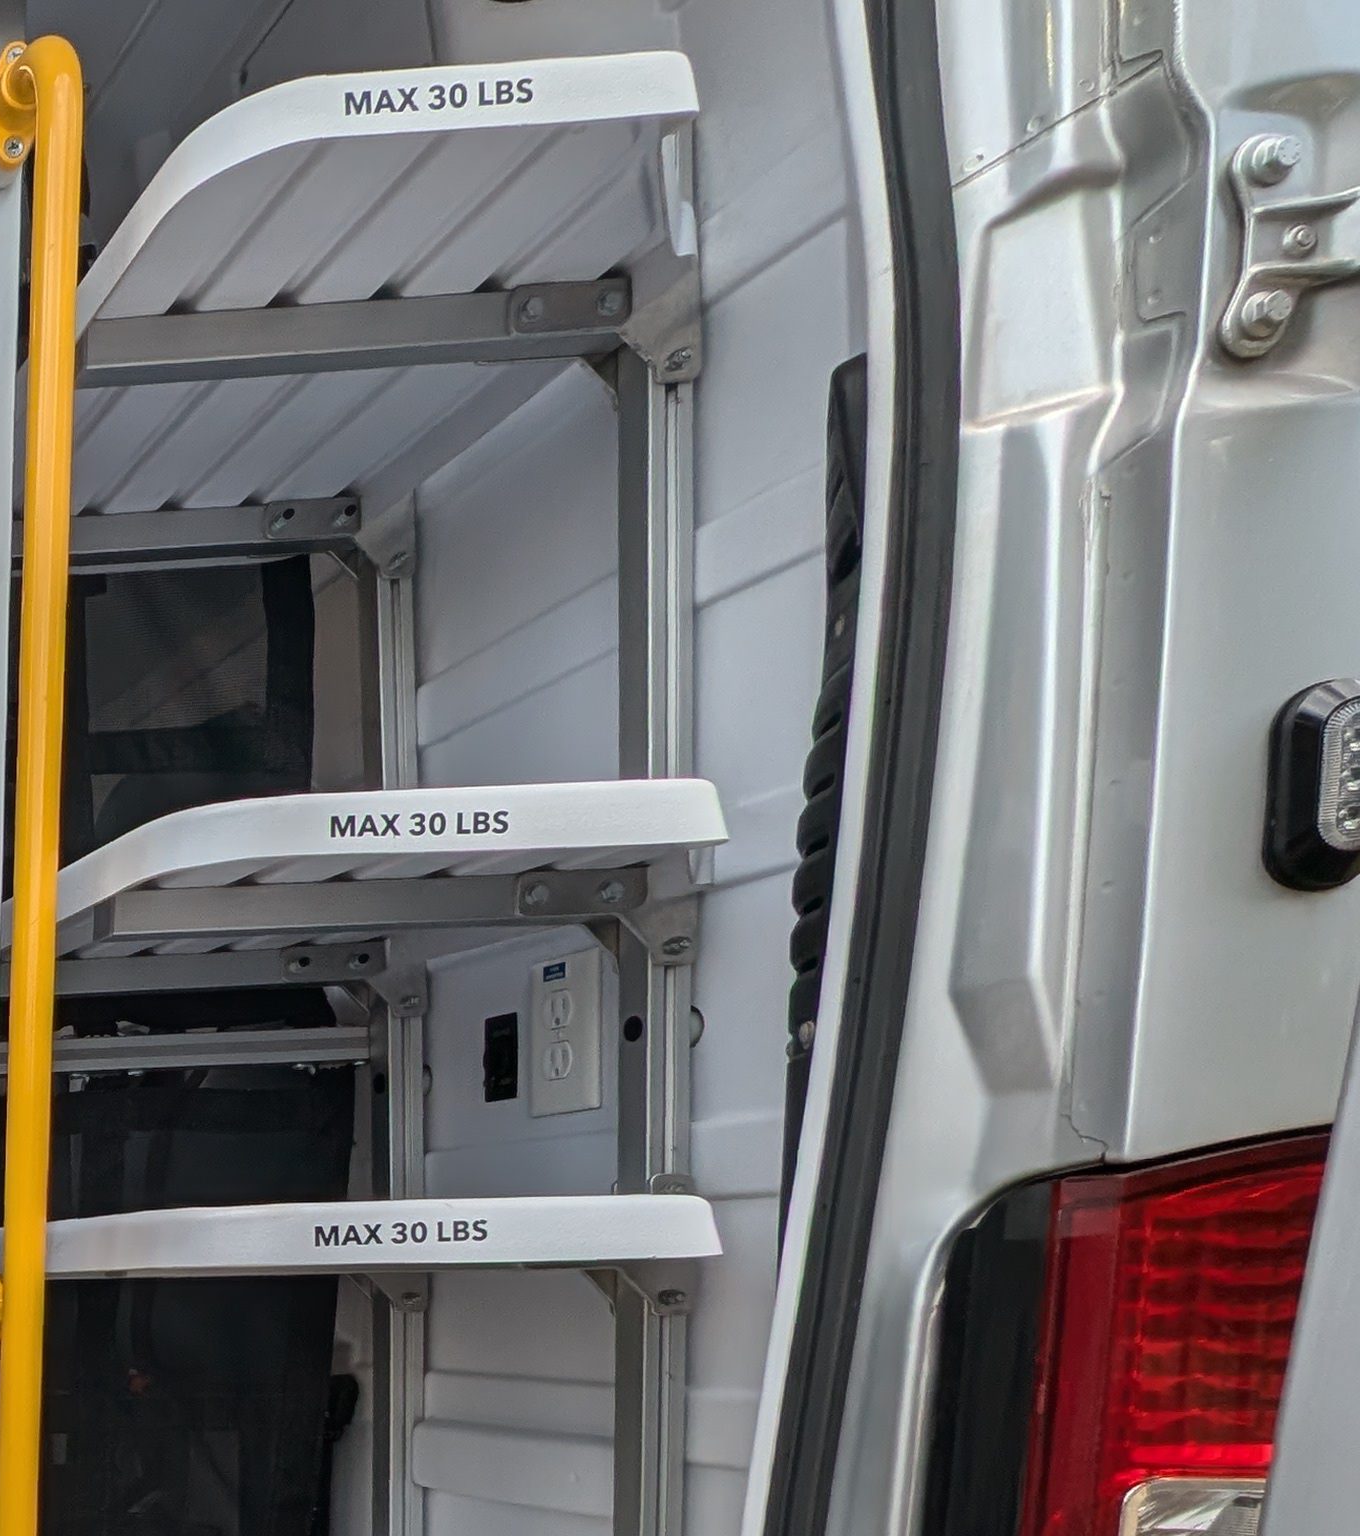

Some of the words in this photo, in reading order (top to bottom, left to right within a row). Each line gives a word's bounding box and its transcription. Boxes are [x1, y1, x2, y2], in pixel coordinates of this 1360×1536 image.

[344, 86, 419, 116] MAX
[427, 83, 468, 110] 30
[478, 78, 534, 106] LBS
[330, 813, 401, 838] MAX
[408, 812, 446, 836] 30
[456, 810, 509, 835] LBS
[314, 1223, 383, 1247] MAX
[390, 1221, 428, 1244] 30
[437, 1219, 488, 1242] LBS
